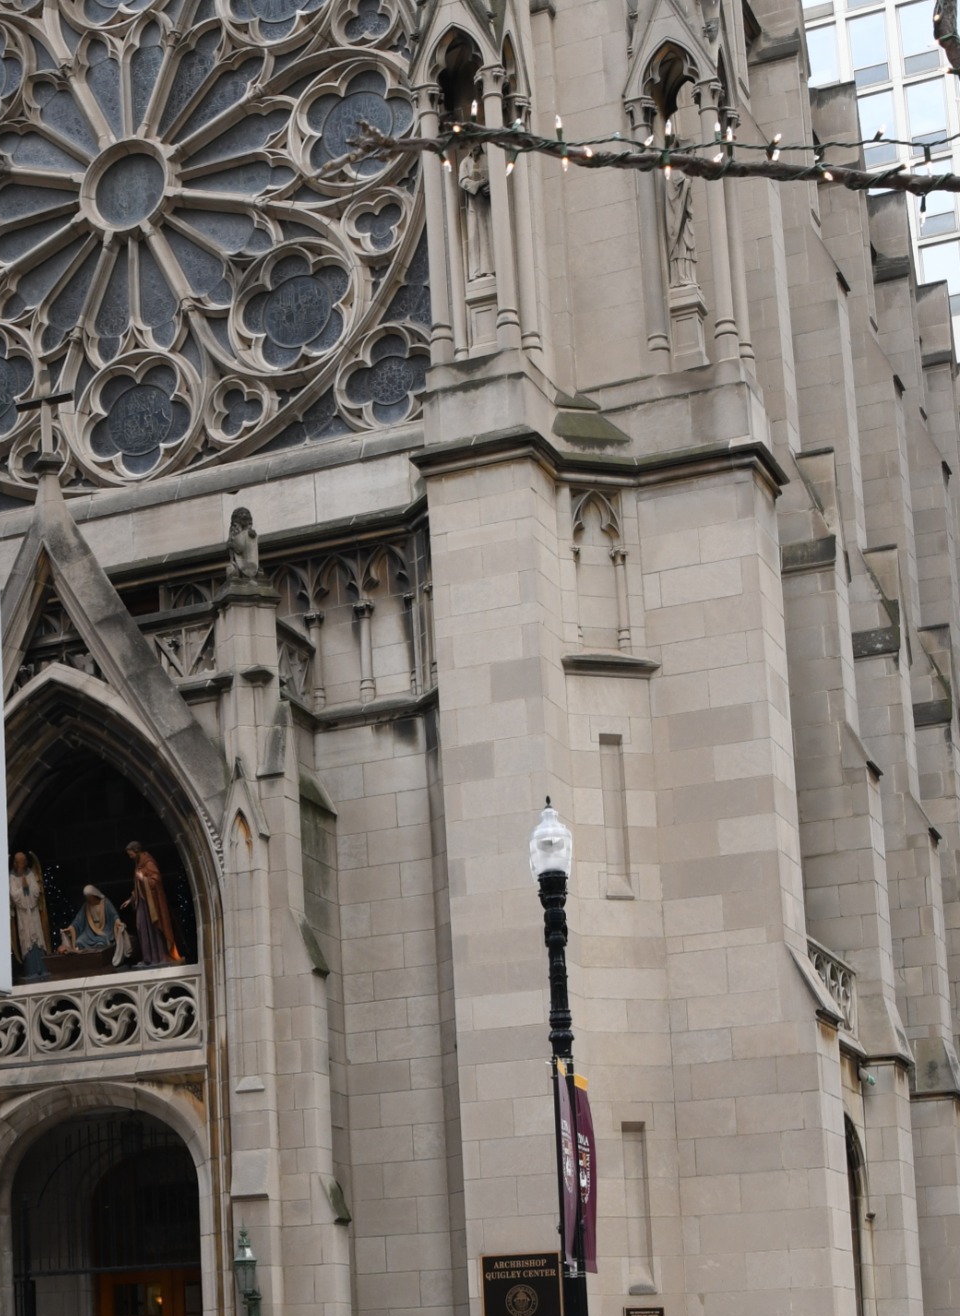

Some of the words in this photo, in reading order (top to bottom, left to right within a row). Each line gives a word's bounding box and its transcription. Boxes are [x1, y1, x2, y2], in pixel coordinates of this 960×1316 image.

[493, 1259, 547, 1269] ARCHBISHOP
[485, 1270, 522, 1280] QUIGLEY
[522, 1269, 556, 1278] CENTER
